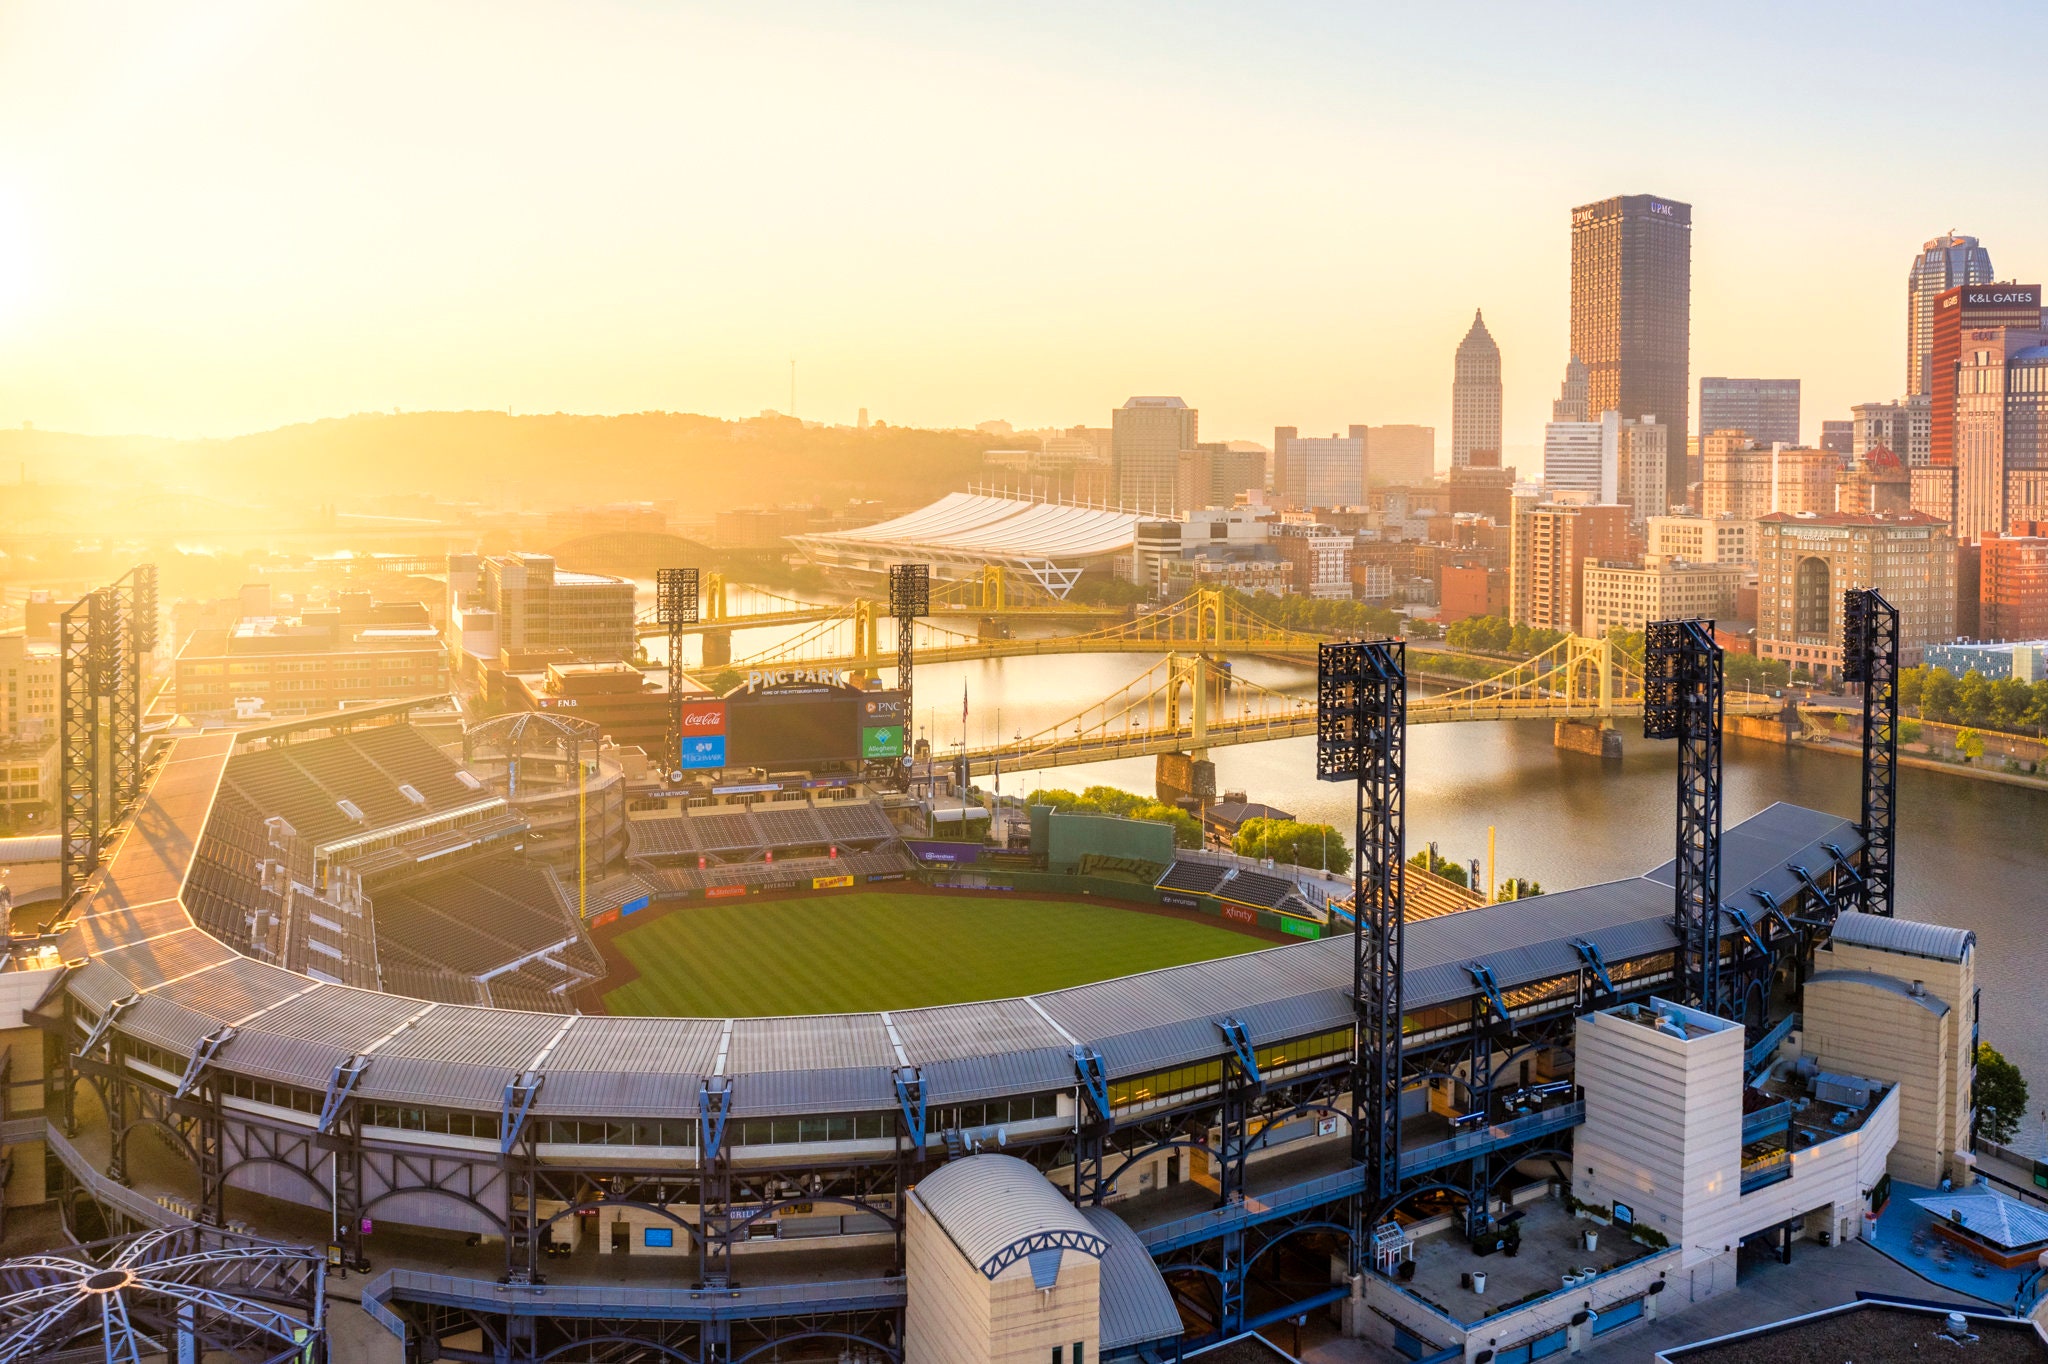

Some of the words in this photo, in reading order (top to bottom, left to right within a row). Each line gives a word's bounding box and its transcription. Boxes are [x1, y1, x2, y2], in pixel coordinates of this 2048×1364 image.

[1651, 201, 1673, 216] UPMC
[1969, 294, 1990, 303] K&L
[1993, 293, 2032, 303] GATES
[747, 670, 789, 695] PNC
[793, 667, 846, 690] PARK
[877, 702, 901, 712] PNC
[868, 745, 897, 753] Allegheny
[1225, 907, 1254, 922] xfinity
